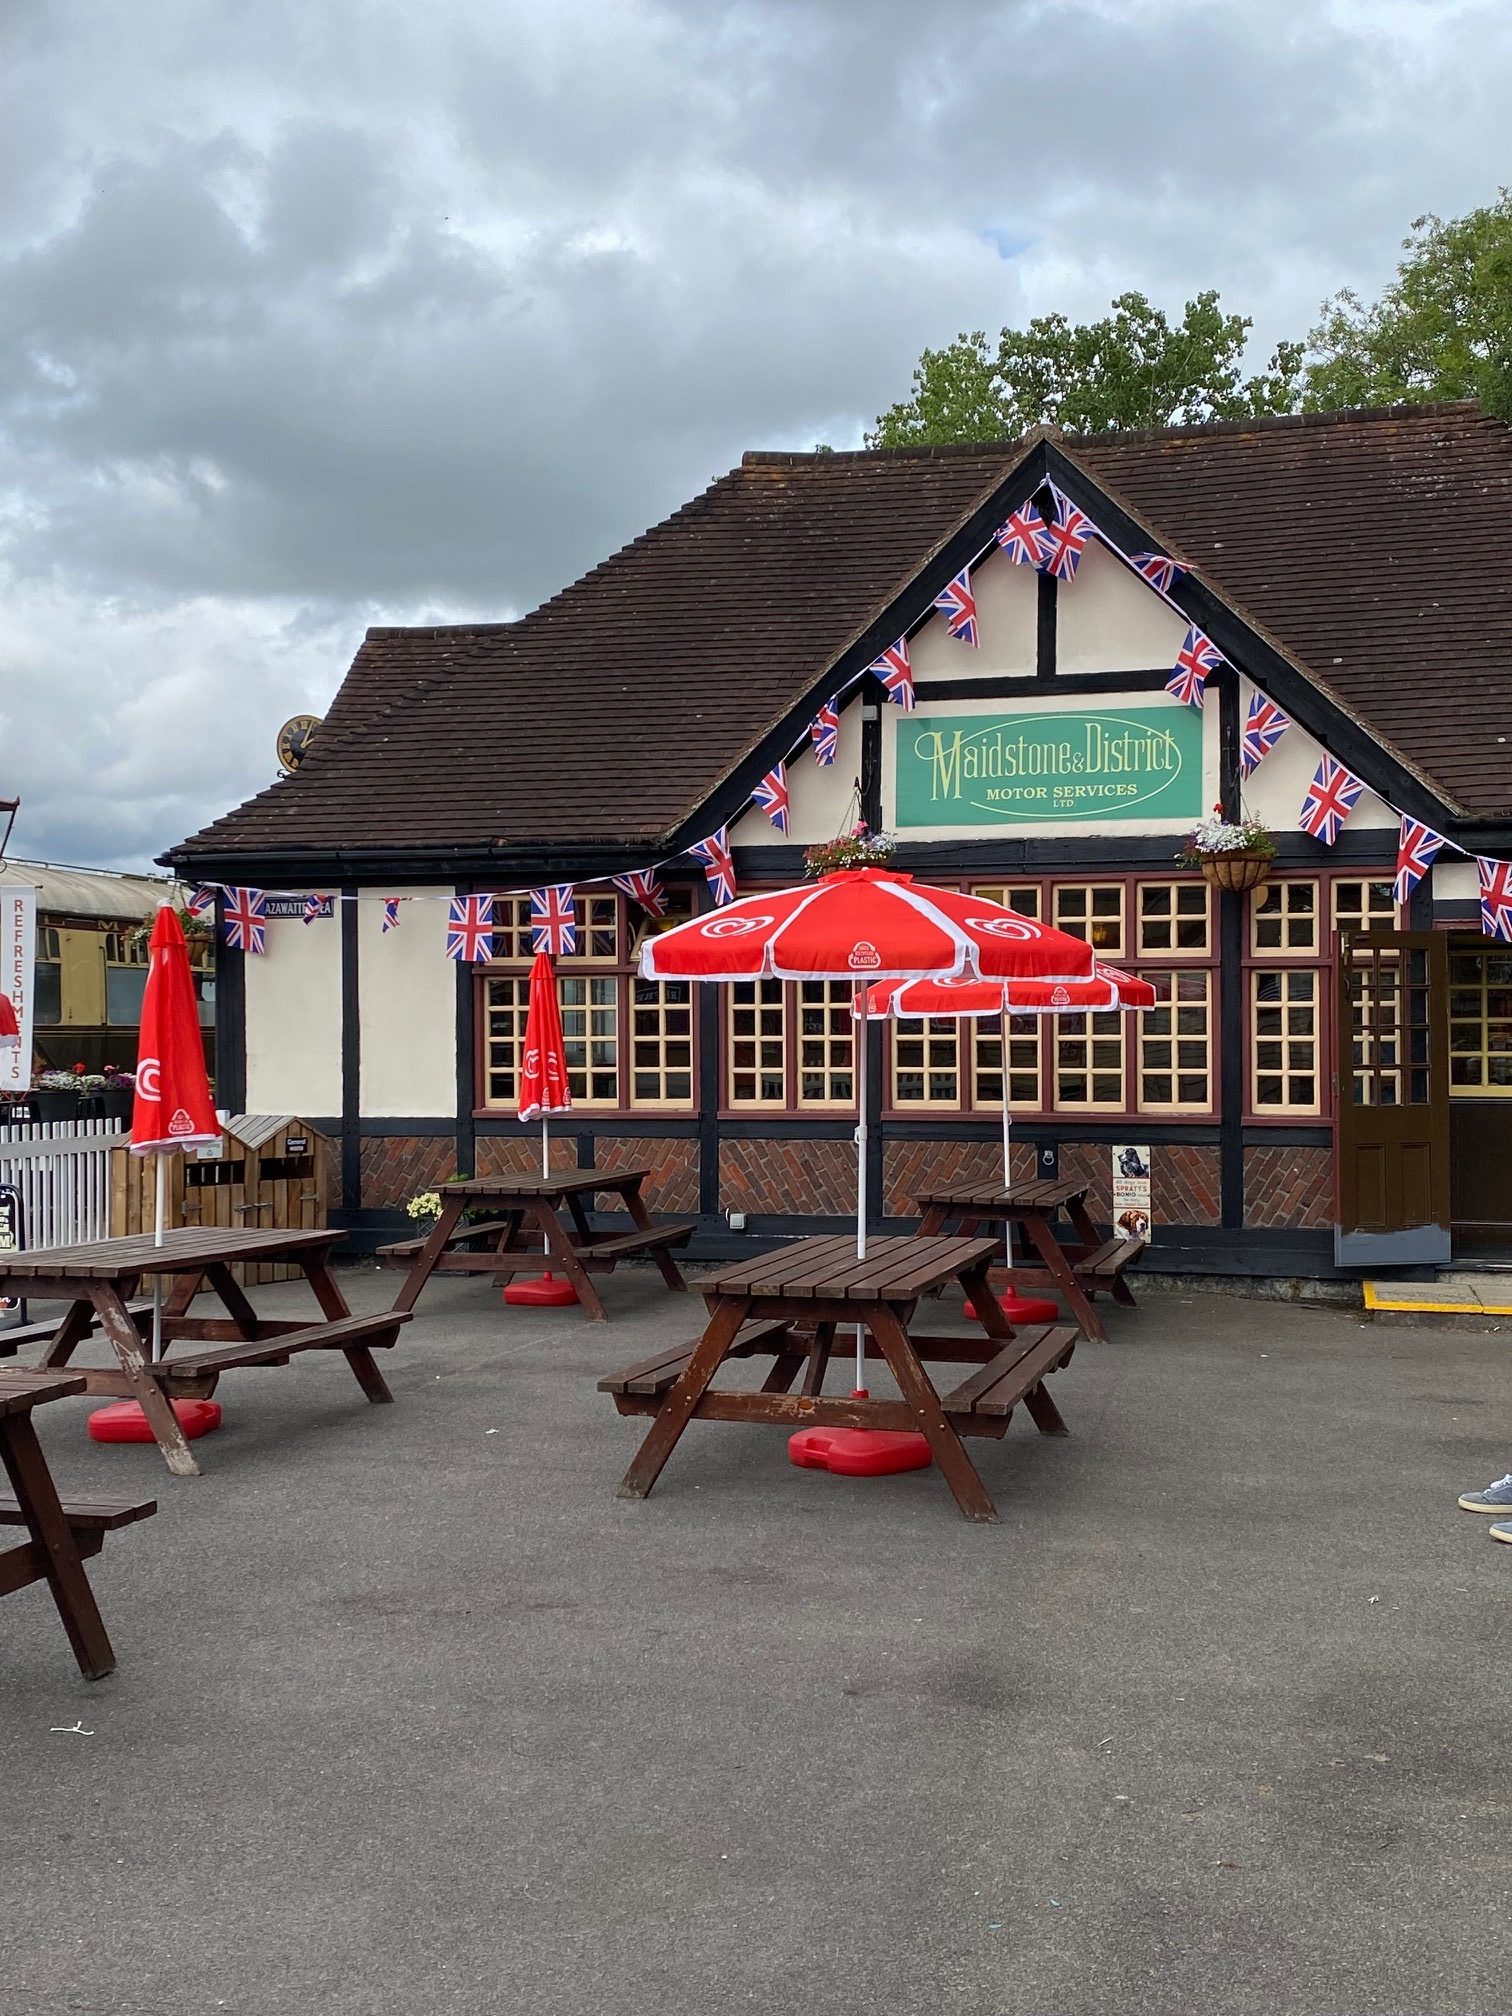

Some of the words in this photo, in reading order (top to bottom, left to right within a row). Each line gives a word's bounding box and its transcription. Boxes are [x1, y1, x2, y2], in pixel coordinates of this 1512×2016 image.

[929, 730, 1071, 801] Maidstone
[1072, 752, 1084, 773] &
[1085, 723, 1174, 773] District
[986, 787, 1047, 800] MOTOR
[1053, 784, 1137, 798] SERVICES
[853, 956, 877, 964] PLASTIC
